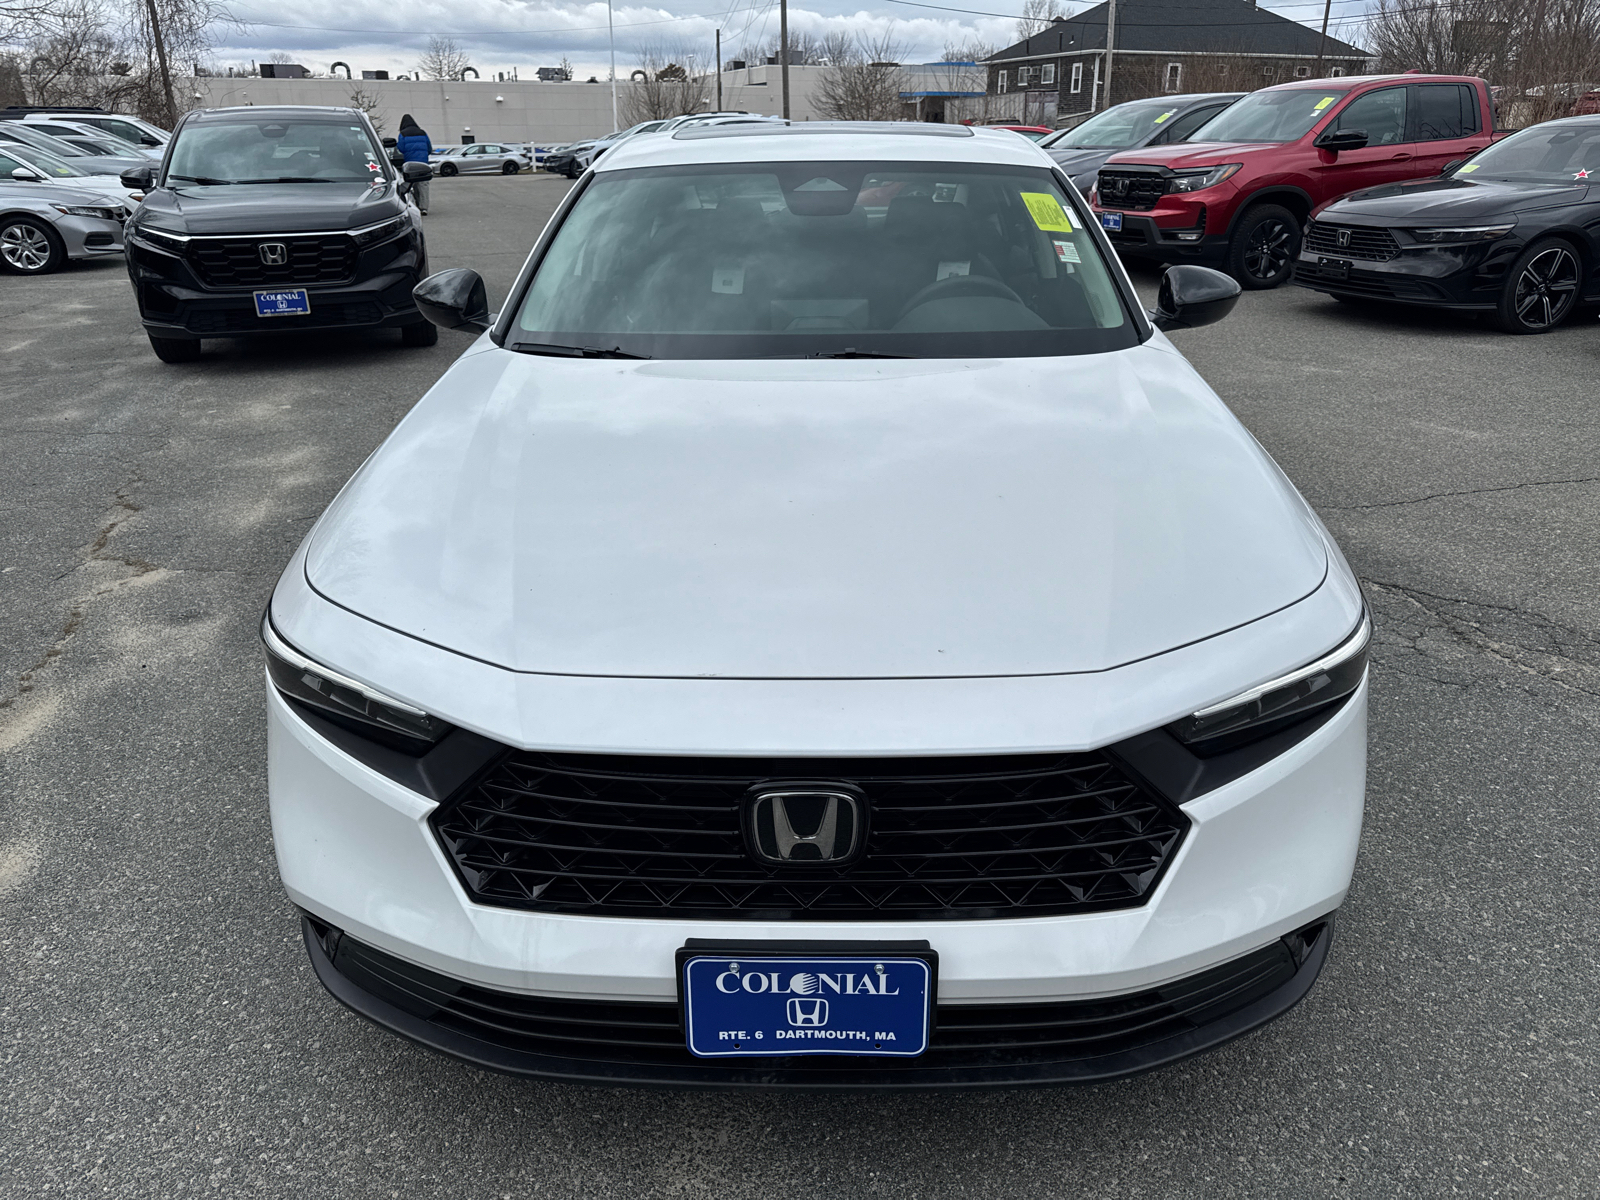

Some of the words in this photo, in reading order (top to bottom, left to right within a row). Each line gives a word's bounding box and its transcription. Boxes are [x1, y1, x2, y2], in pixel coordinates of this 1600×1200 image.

[715, 971, 900, 995] COLONIAL
[719, 1030, 751, 1040] RTE.
[754, 1030, 764, 1040] 6
[775, 1029, 870, 1042] DARTMOUTH,
[874, 1031, 897, 1041] MA
